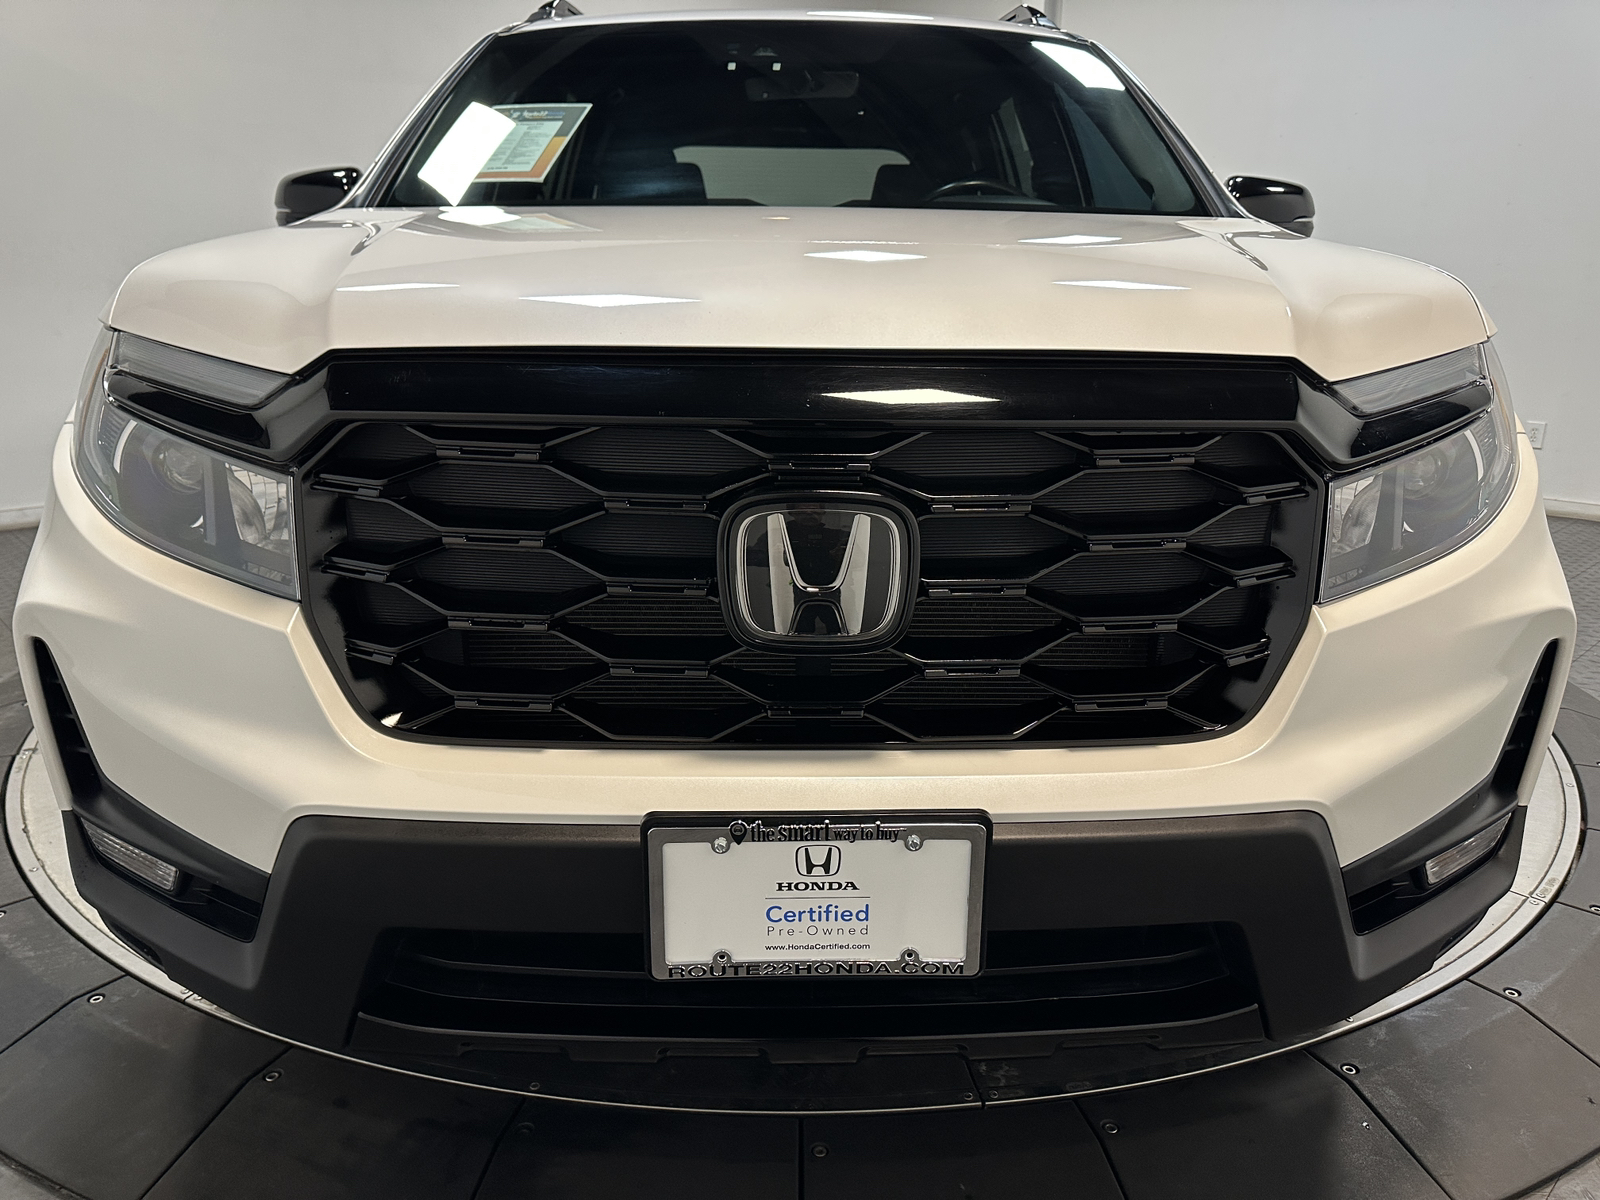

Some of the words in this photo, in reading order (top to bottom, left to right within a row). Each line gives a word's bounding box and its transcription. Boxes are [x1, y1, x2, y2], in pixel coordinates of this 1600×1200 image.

[750, 820, 775, 842] the
[777, 819, 831, 842] smart
[833, 828, 858, 843] way
[860, 825, 874, 841] to
[875, 821, 900, 843] buy
[776, 881, 860, 891] HONDA
[765, 903, 870, 923] Certified
[767, 924, 869, 937] Pre-Owned
[764, 943, 871, 951] www.HondaCertified.com
[667, 962, 966, 978] ROUTE22HONDA.COM
